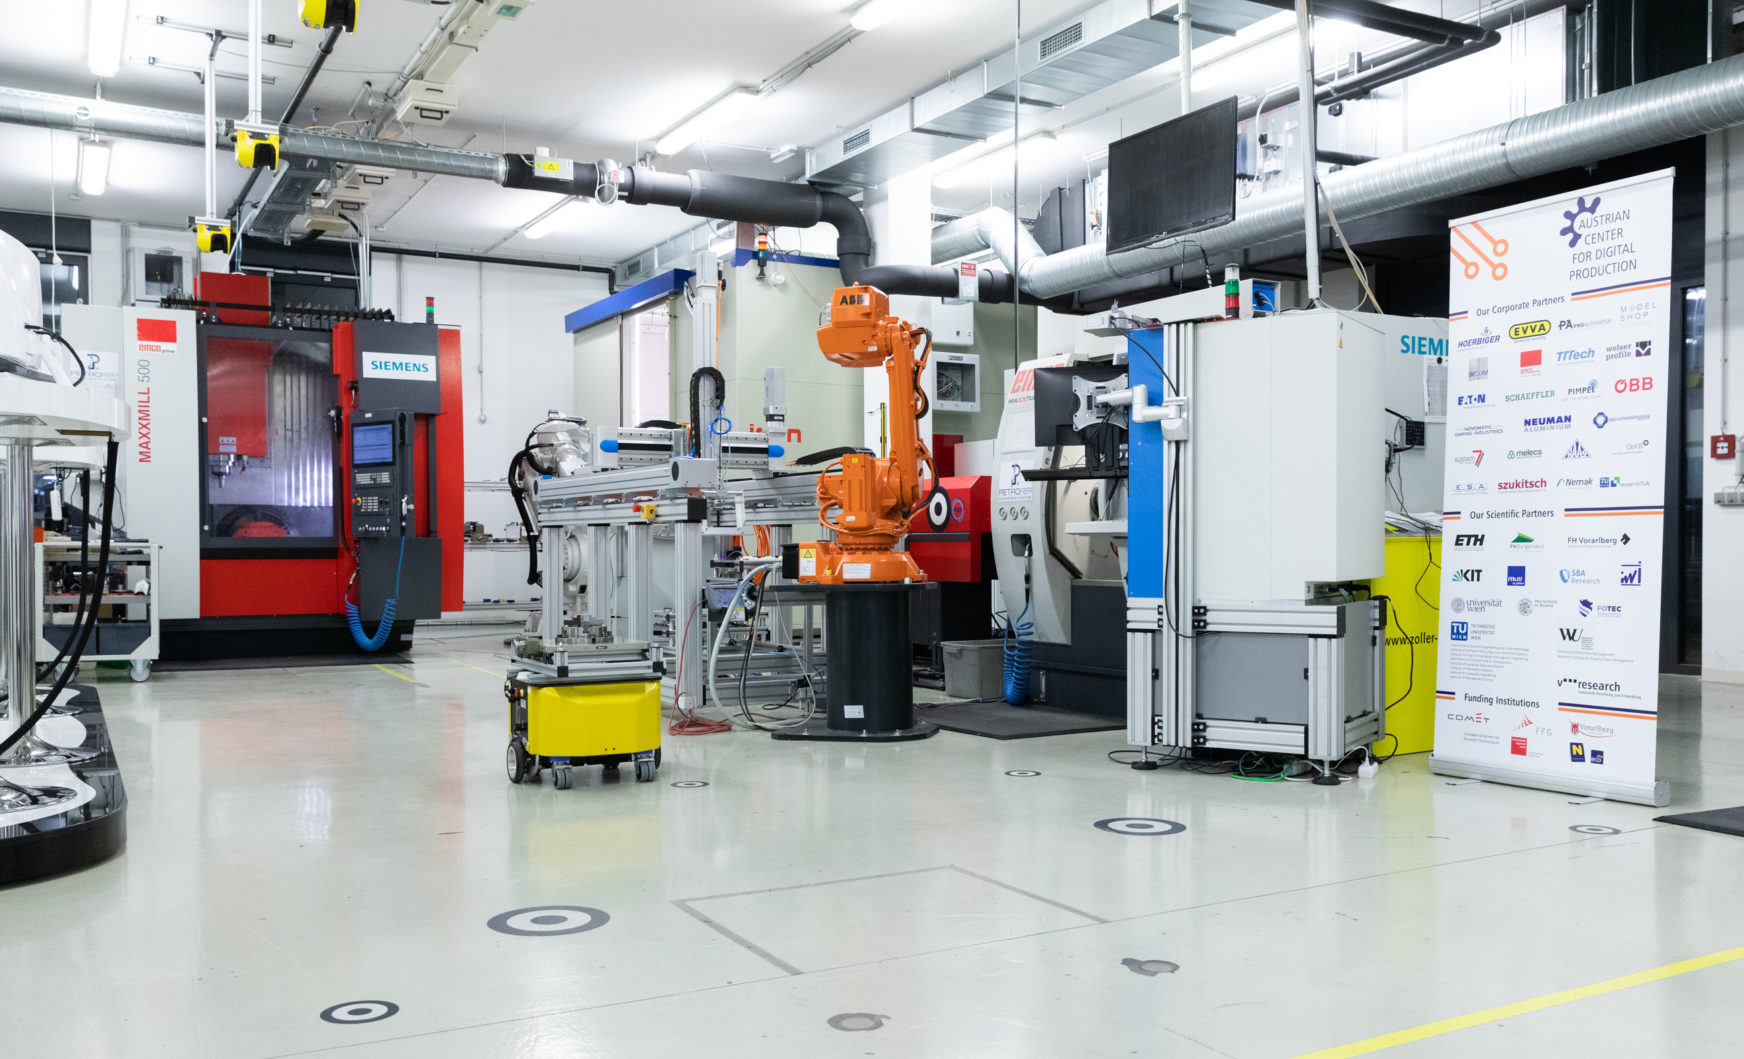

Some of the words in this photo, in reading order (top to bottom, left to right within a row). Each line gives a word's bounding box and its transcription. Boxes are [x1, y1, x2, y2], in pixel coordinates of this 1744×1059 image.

[1579, 209, 1631, 230] AUSTRIAN
[1584, 228, 1623, 246] CENTER
[1572, 250, 1593, 264] FOR
[1596, 243, 1636, 261] DIGITAL
[1569, 259, 1637, 281] PRODUCTION
[840, 294, 864, 306] ABB
[1476, 308, 1490, 317] Our
[1492, 301, 1530, 315] Corporate
[1532, 295, 1565, 308] Partners
[1514, 323, 1546, 336] EVVA
[1457, 335, 1501, 348] HOERBIGER
[1606, 343, 1632, 353] welser
[1605, 351, 1632, 361] profile
[137, 359, 151, 383] 500
[371, 360, 429, 373] SIEMENS
[1505, 390, 1556, 402] SCHAEFFLER
[1568, 386, 1596, 396] PIMPEL
[137, 386, 152, 463] MAXXMILL
[1523, 415, 1572, 427] NEUMAN
[1523, 424, 1572, 433] ALUMINIUM
[1516, 448, 1542, 457] melecs
[1497, 478, 1547, 490] szukitsch
[1565, 477, 1593, 486] Nemak
[1469, 510, 1485, 519] Our
[1486, 509, 1519, 519] Scientific
[1521, 509, 1554, 518] Partners
[1454, 534, 1485, 546] ETH
[1578, 536, 1617, 546] Vorarlberg
[1460, 569, 1483, 582] KIT
[1571, 569, 1586, 577] SBA
[1452, 622, 1467, 634] TU
[1464, 693, 1494, 706] Funding
[1495, 696, 1540, 709] Institutions
[1447, 712, 1490, 724] COMET
[1571, 744, 1583, 756] N
